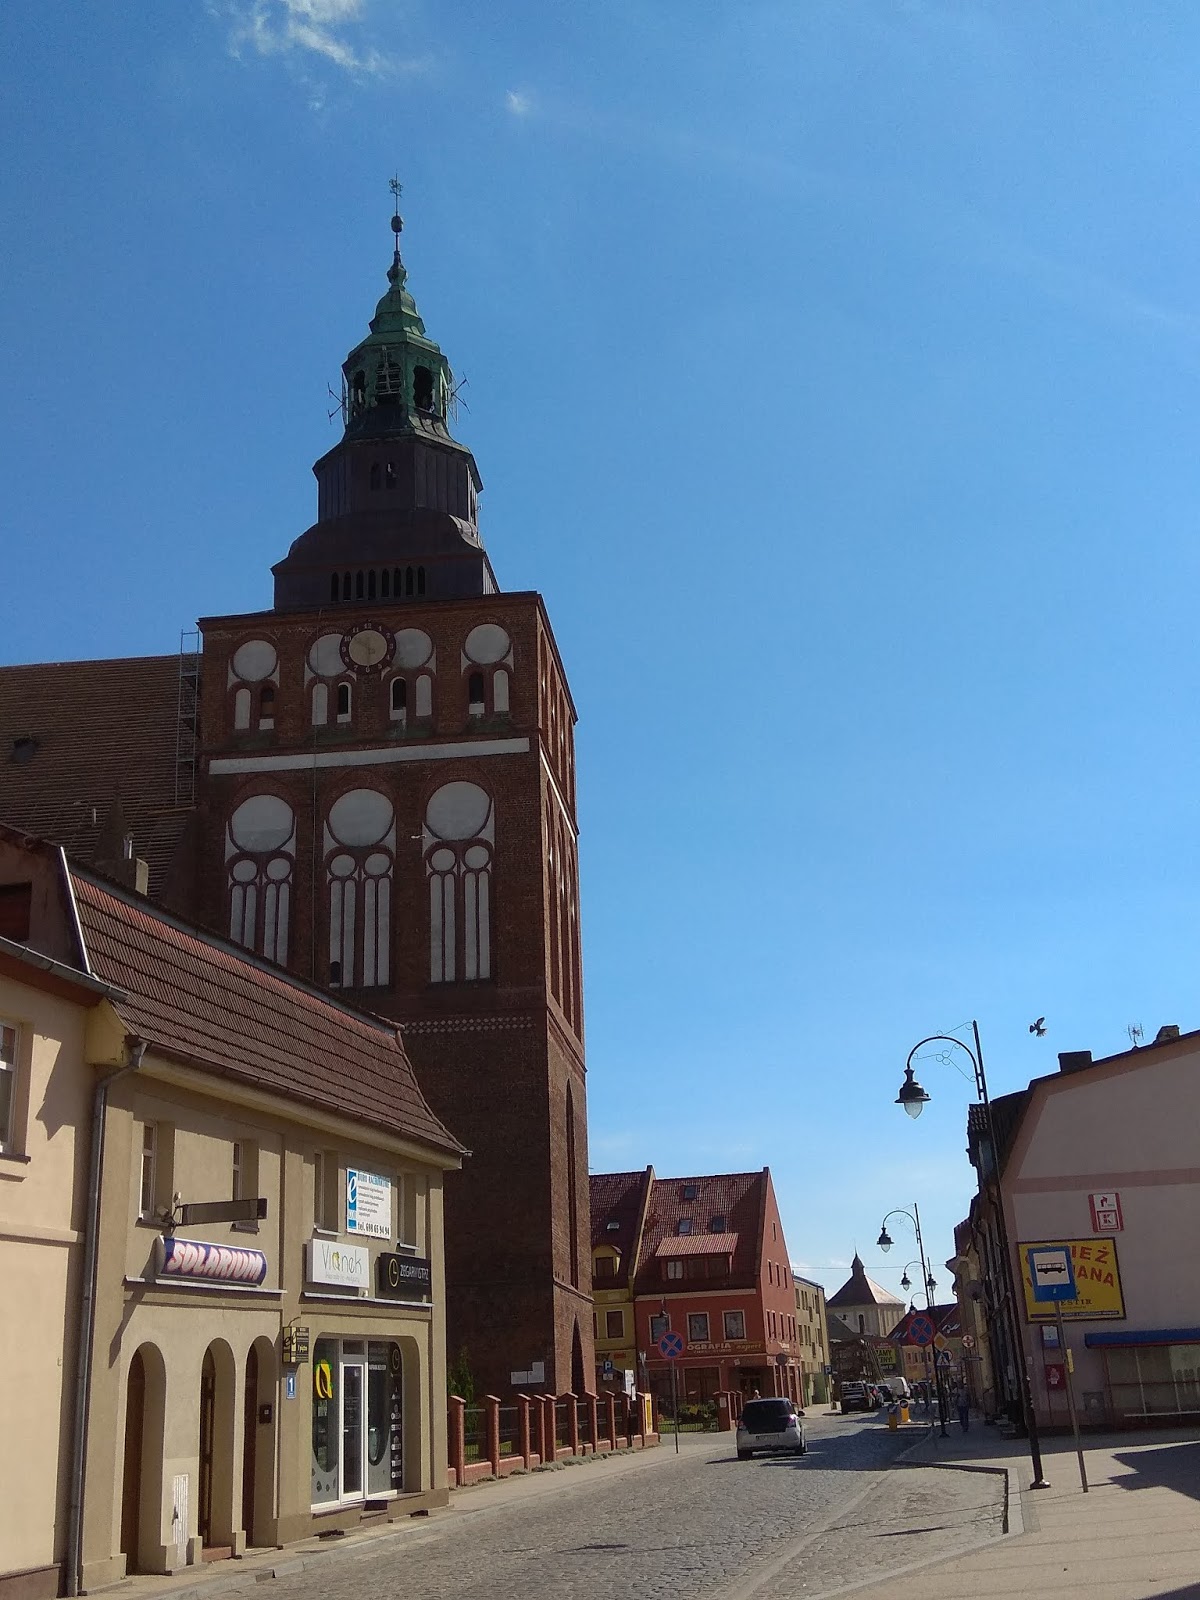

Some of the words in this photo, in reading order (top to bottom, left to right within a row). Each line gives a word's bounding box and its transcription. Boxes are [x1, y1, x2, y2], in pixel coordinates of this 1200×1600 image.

[167, 1242, 263, 1281] SOLARIUM
[686, 1342, 732, 1351] OGRAFIA
[604, 1361, 612, 1370] P
[289, 1377, 293, 1392] 1
